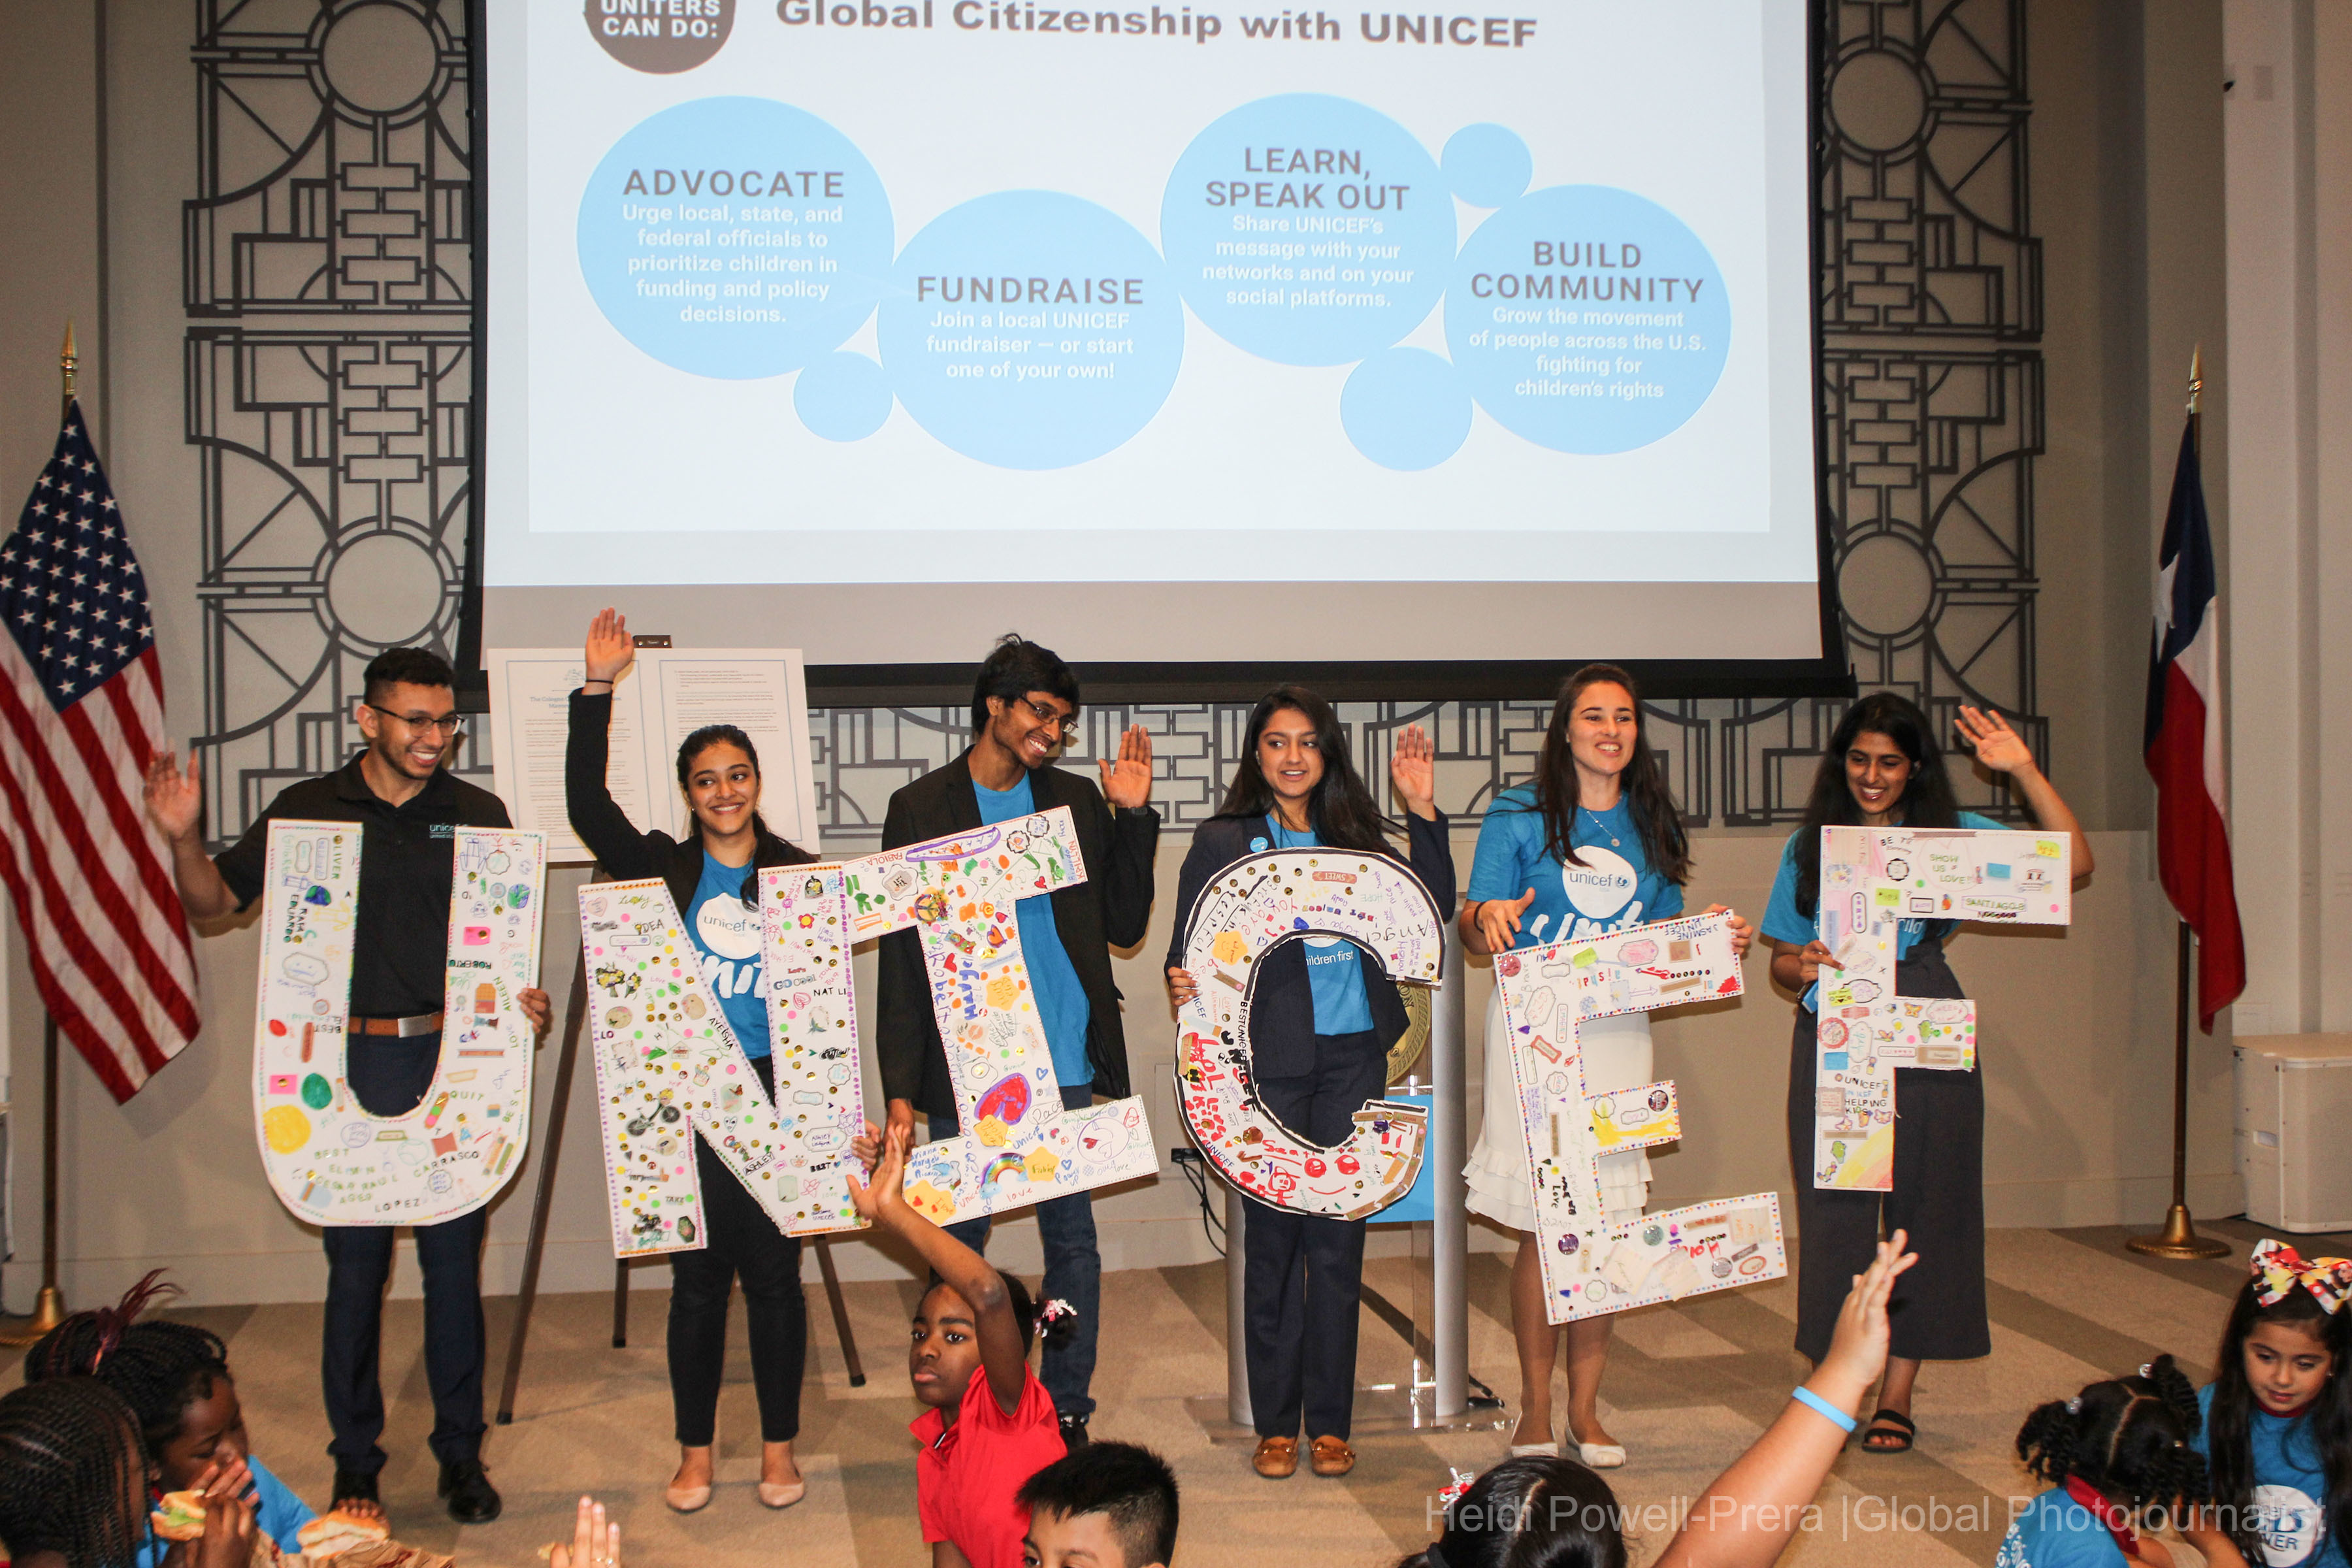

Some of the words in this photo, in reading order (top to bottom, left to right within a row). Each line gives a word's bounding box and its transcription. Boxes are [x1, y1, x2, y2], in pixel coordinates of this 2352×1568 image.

[603, 18, 661, 38] CAN
[670, 18, 719, 39] DO:
[776, 0, 934, 28] Global
[953, 0, 1222, 44] Citizenship
[1239, 8, 1341, 41] with
[1360, 12, 1538, 48] UNICEF
[1244, 147, 1372, 180] LEARN,
[623, 169, 845, 199] ADVOCATE
[1205, 180, 1326, 209] SPEAK
[1337, 184, 1410, 211] OUT
[623, 203, 673, 225] Urge
[680, 203, 734, 225] local,
[741, 205, 798, 226] state,
[804, 204, 843, 223] and
[1233, 214, 1290, 234] Share
[638, 227, 711, 248] federal
[717, 227, 801, 248] officials
[806, 231, 828, 248] to
[1215, 241, 1306, 262] message
[1311, 240, 1352, 258] with
[1357, 244, 1401, 263] your
[1533, 240, 1642, 269] BUILD
[627, 253, 722, 277] prioritize
[729, 253, 811, 274] children
[819, 255, 838, 274] in
[1202, 263, 1294, 282] networks
[1299, 264, 1335, 283] and
[1342, 269, 1365, 283] on
[1370, 269, 1414, 287] your
[636, 279, 716, 304] funding
[723, 279, 761, 299] and
[768, 279, 830, 303] policy
[917, 276, 1144, 305] FUNDRAISE
[1226, 287, 1284, 306] social
[1290, 288, 1391, 310] platforms.
[1470, 273, 1704, 304] COMMUNITY
[680, 303, 787, 324] decisions.
[930, 311, 974, 330] Join
[981, 316, 993, 330] a
[999, 311, 1047, 331] local
[1053, 311, 1130, 331] UNICEF
[1493, 307, 1541, 325] Grow
[1548, 308, 1578, 326] the
[1583, 311, 1684, 329] movement
[926, 335, 1030, 355] fundraiser
[1060, 339, 1079, 354] or
[1086, 336, 1134, 355] start
[1469, 331, 1490, 348] of
[1494, 332, 1558, 353] people
[1564, 336, 1627, 351] across
[1633, 333, 1663, 351] the
[1668, 335, 1707, 353] U.S.
[945, 364, 983, 380] one
[989, 359, 1011, 380] of
[1016, 364, 1060, 384] your
[1066, 359, 1115, 380] own!
[1535, 355, 1610, 377] fighting
[1614, 356, 1642, 374] for
[1609, 380, 1665, 400] rights
[429, 823, 455, 832] unice
[866, 852, 904, 866] FABIOLA
[1929, 853, 1960, 863] SHOW
[1324, 872, 1347, 881] SWEET
[1569, 870, 1614, 888] unicef
[704, 915, 747, 932] unicef
[1677, 924, 1719, 941] JASMINE
[1337, 951, 1354, 962] first
[1193, 996, 1207, 1019] ICEF
[1844, 1075, 1882, 1090] UNICEF
[744, 1152, 774, 1175] ASHLEY
[1205, 1141, 1235, 1168] UNICEF
[374, 1199, 420, 1213] LOPEZ
[1551, 1184, 1561, 1209] Love
